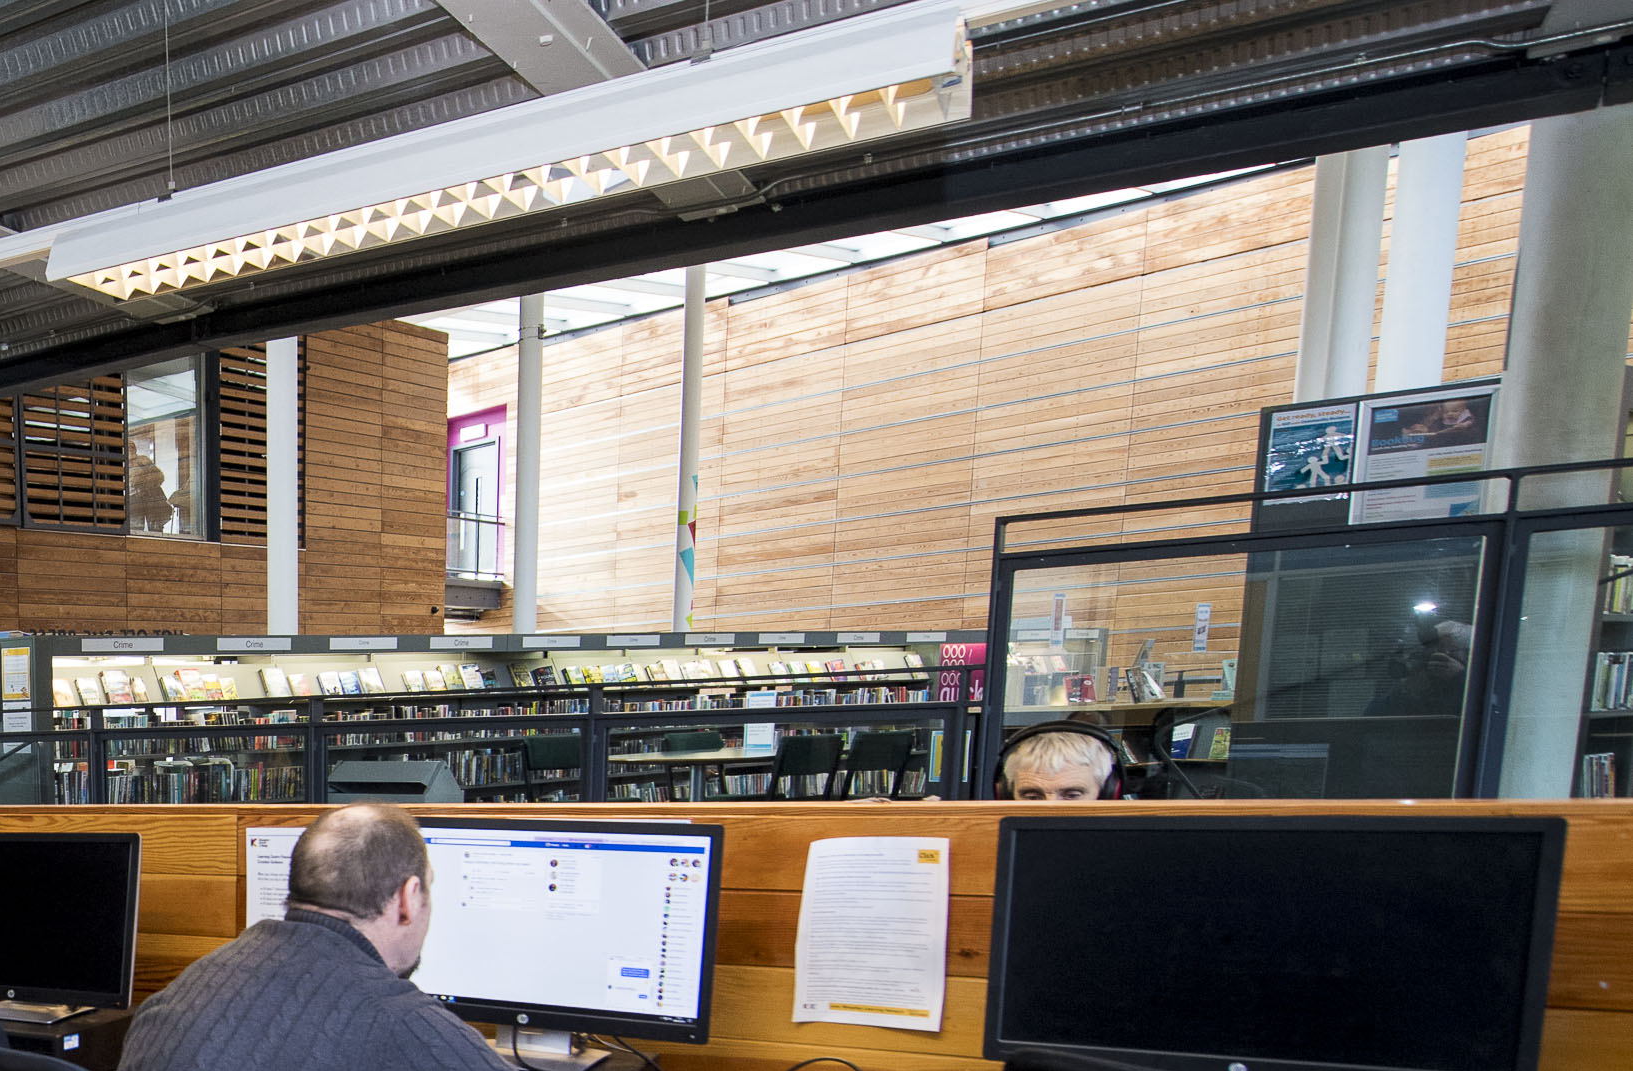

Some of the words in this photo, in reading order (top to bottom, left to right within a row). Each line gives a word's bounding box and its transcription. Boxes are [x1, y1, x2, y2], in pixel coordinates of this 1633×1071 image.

[113, 641, 133, 649] Crime
[246, 640, 263, 648] Crime
[454, 639, 469, 647] Crime
